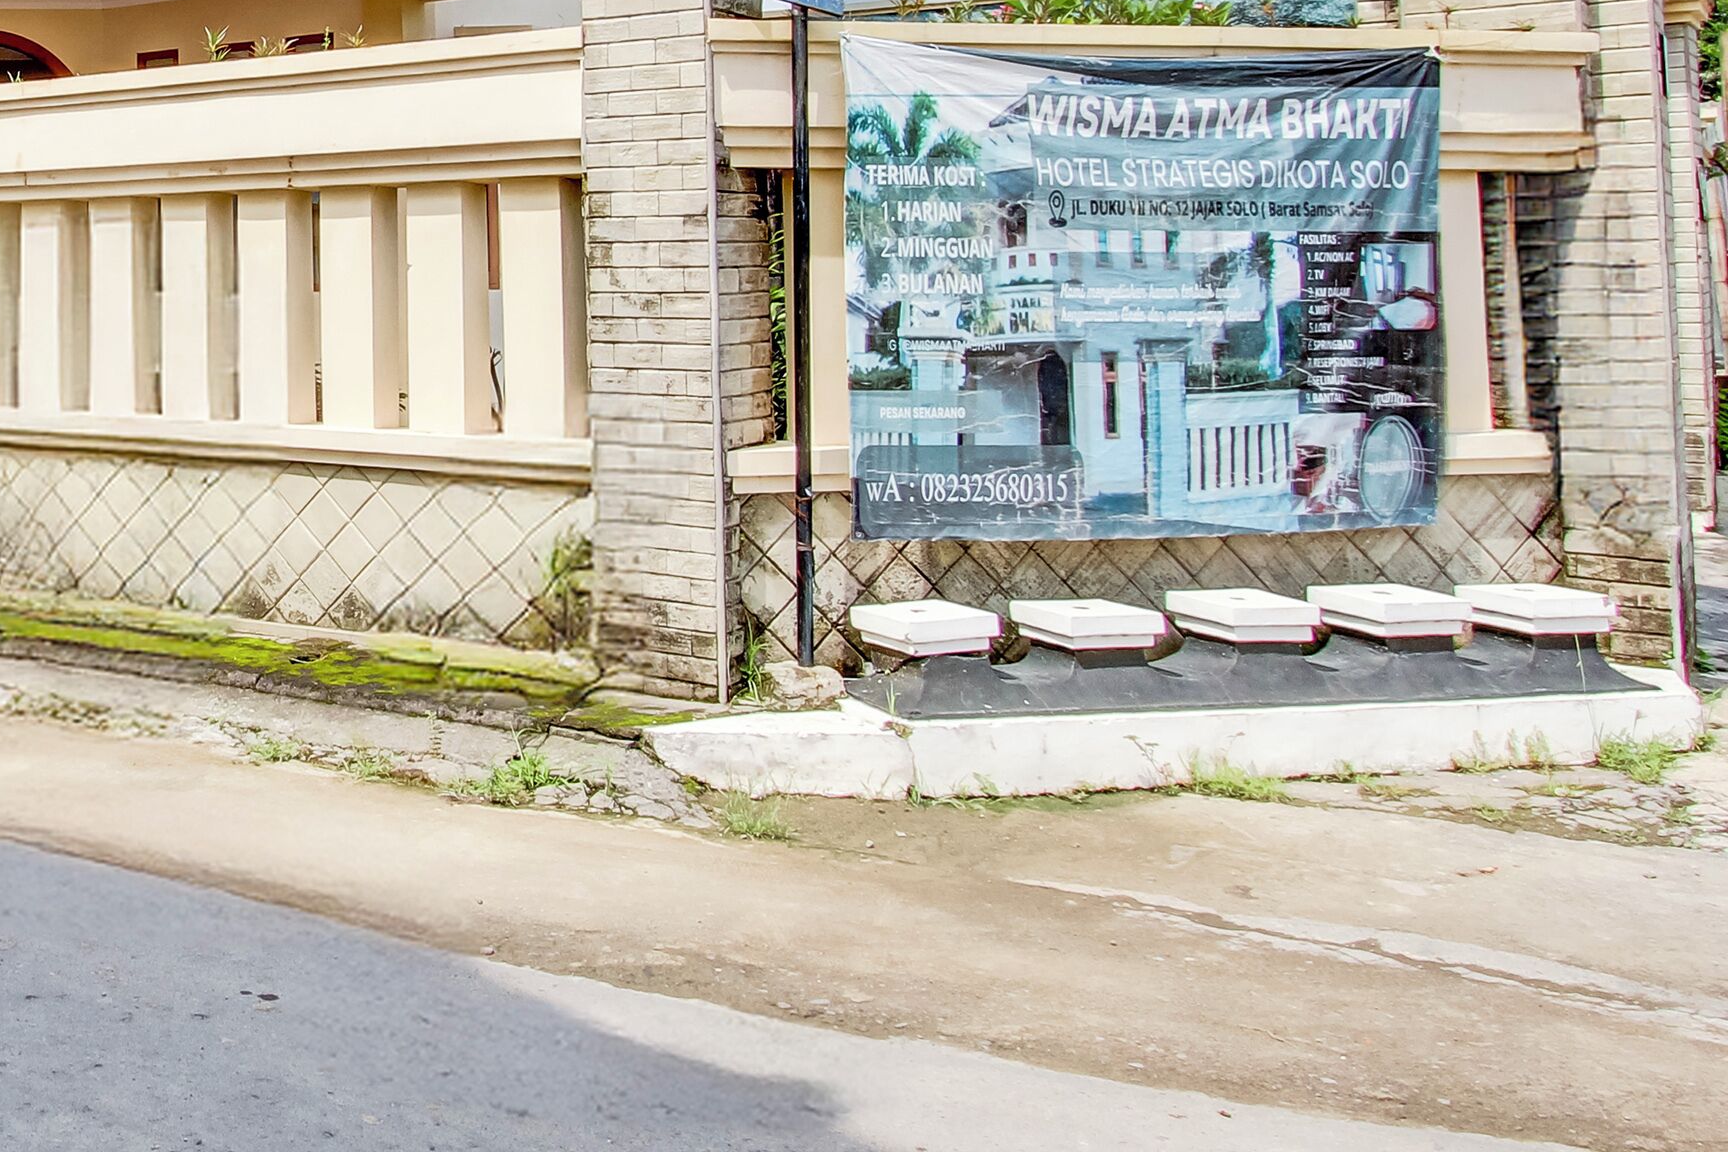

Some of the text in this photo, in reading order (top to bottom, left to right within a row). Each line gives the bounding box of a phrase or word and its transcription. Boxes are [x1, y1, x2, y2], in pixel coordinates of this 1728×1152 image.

[1027, 94, 1411, 140] WISMA ATMA BHAKTI
[865, 164, 930, 186] TERIMA
[934, 166, 976, 186] KOST
[1036, 157, 1410, 189] HOTEL STRATEGIS DIKOTA SOLO
[1071, 200, 1087, 219] JL.
[1090, 200, 1126, 216] DUKU
[1191, 200, 1224, 220] JAJAR
[1227, 201, 1259, 217] SOLO
[1268, 201, 1302, 217] Barat
[880, 407, 966, 419] PESAN SEKARANG
[921, 473, 1069, 503] 082325680315
